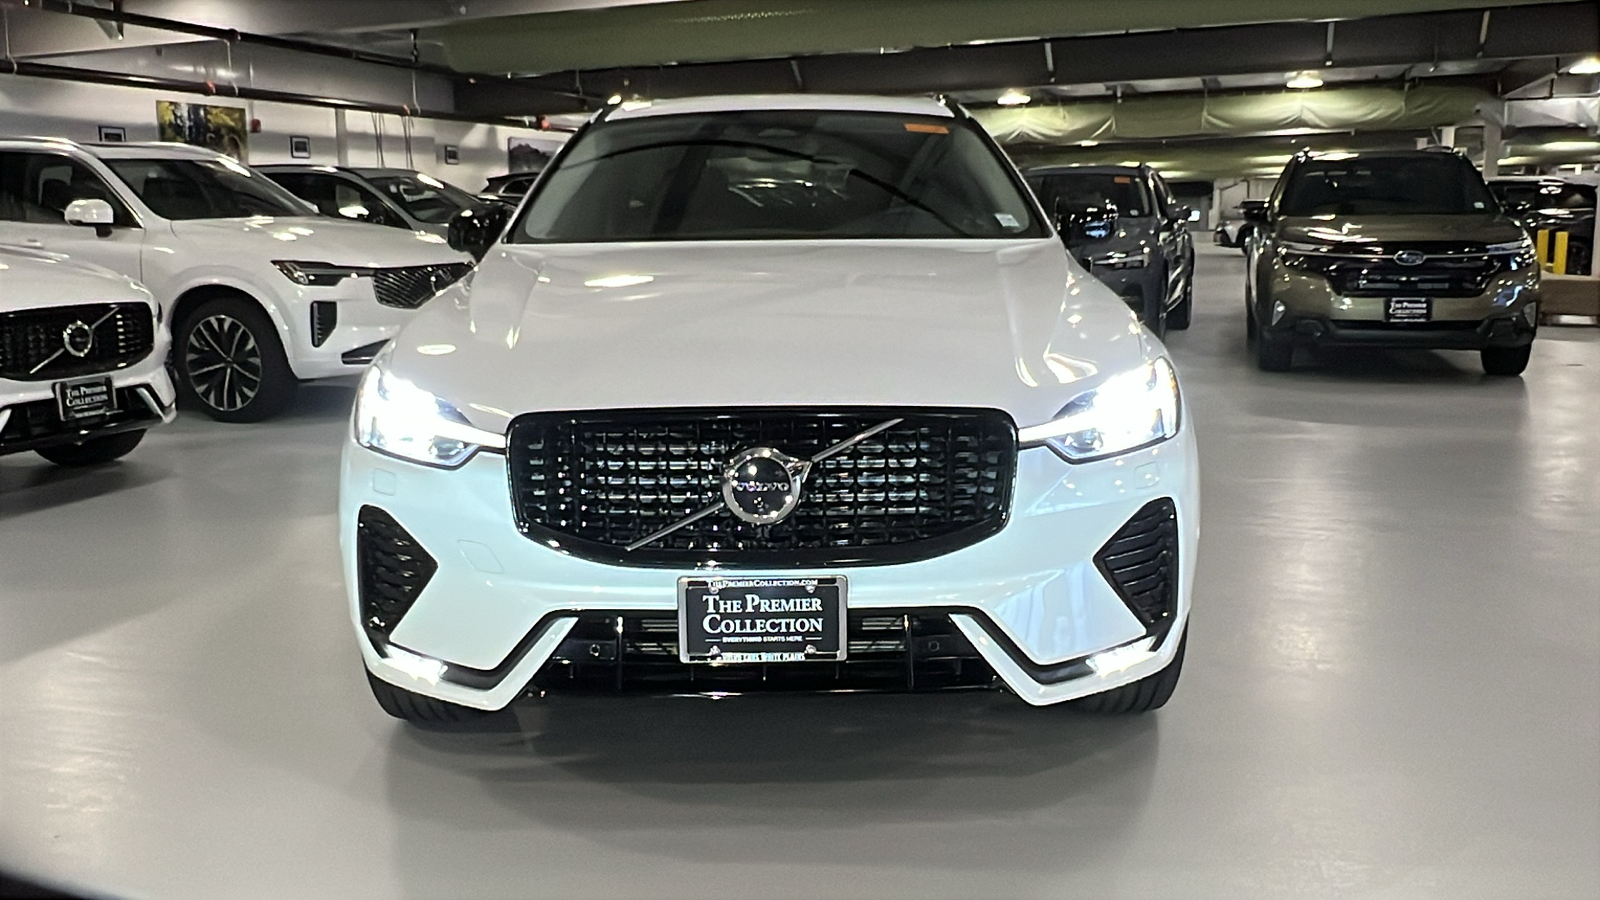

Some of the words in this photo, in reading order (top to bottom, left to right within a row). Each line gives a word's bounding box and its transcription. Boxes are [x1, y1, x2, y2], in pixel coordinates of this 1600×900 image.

[703, 595, 742, 613] THE
[745, 594, 823, 613] PREMIER
[702, 614, 824, 634] COLLECTION
